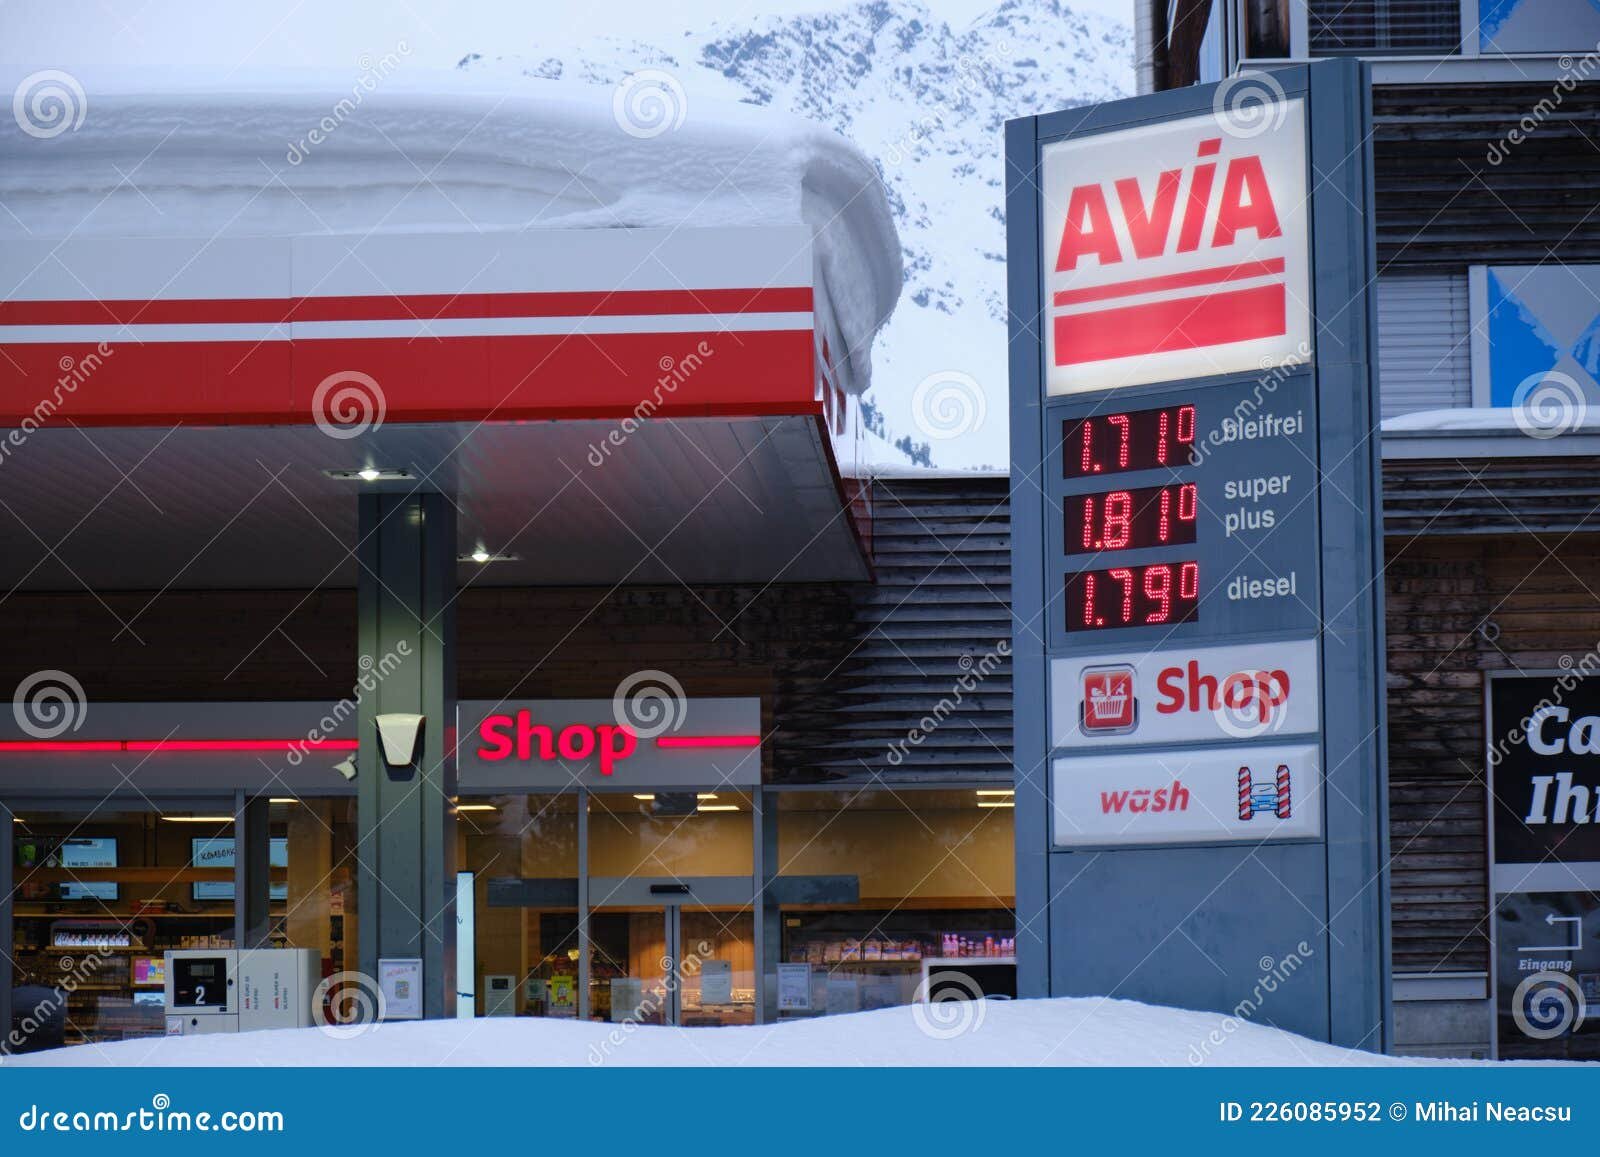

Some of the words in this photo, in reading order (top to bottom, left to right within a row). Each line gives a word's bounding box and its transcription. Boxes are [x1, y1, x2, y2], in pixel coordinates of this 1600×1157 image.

[1222, 410, 1303, 442] bleifrei
[1225, 475, 1292, 503] super
[1225, 507, 1276, 538] plus
[1227, 571, 1297, 601] diesel
[1155, 660, 1291, 724] Shop
[477, 708, 638, 776] Shop
[1518, 959, 1573, 973] Eingang
[195, 985, 206, 1005] 2
